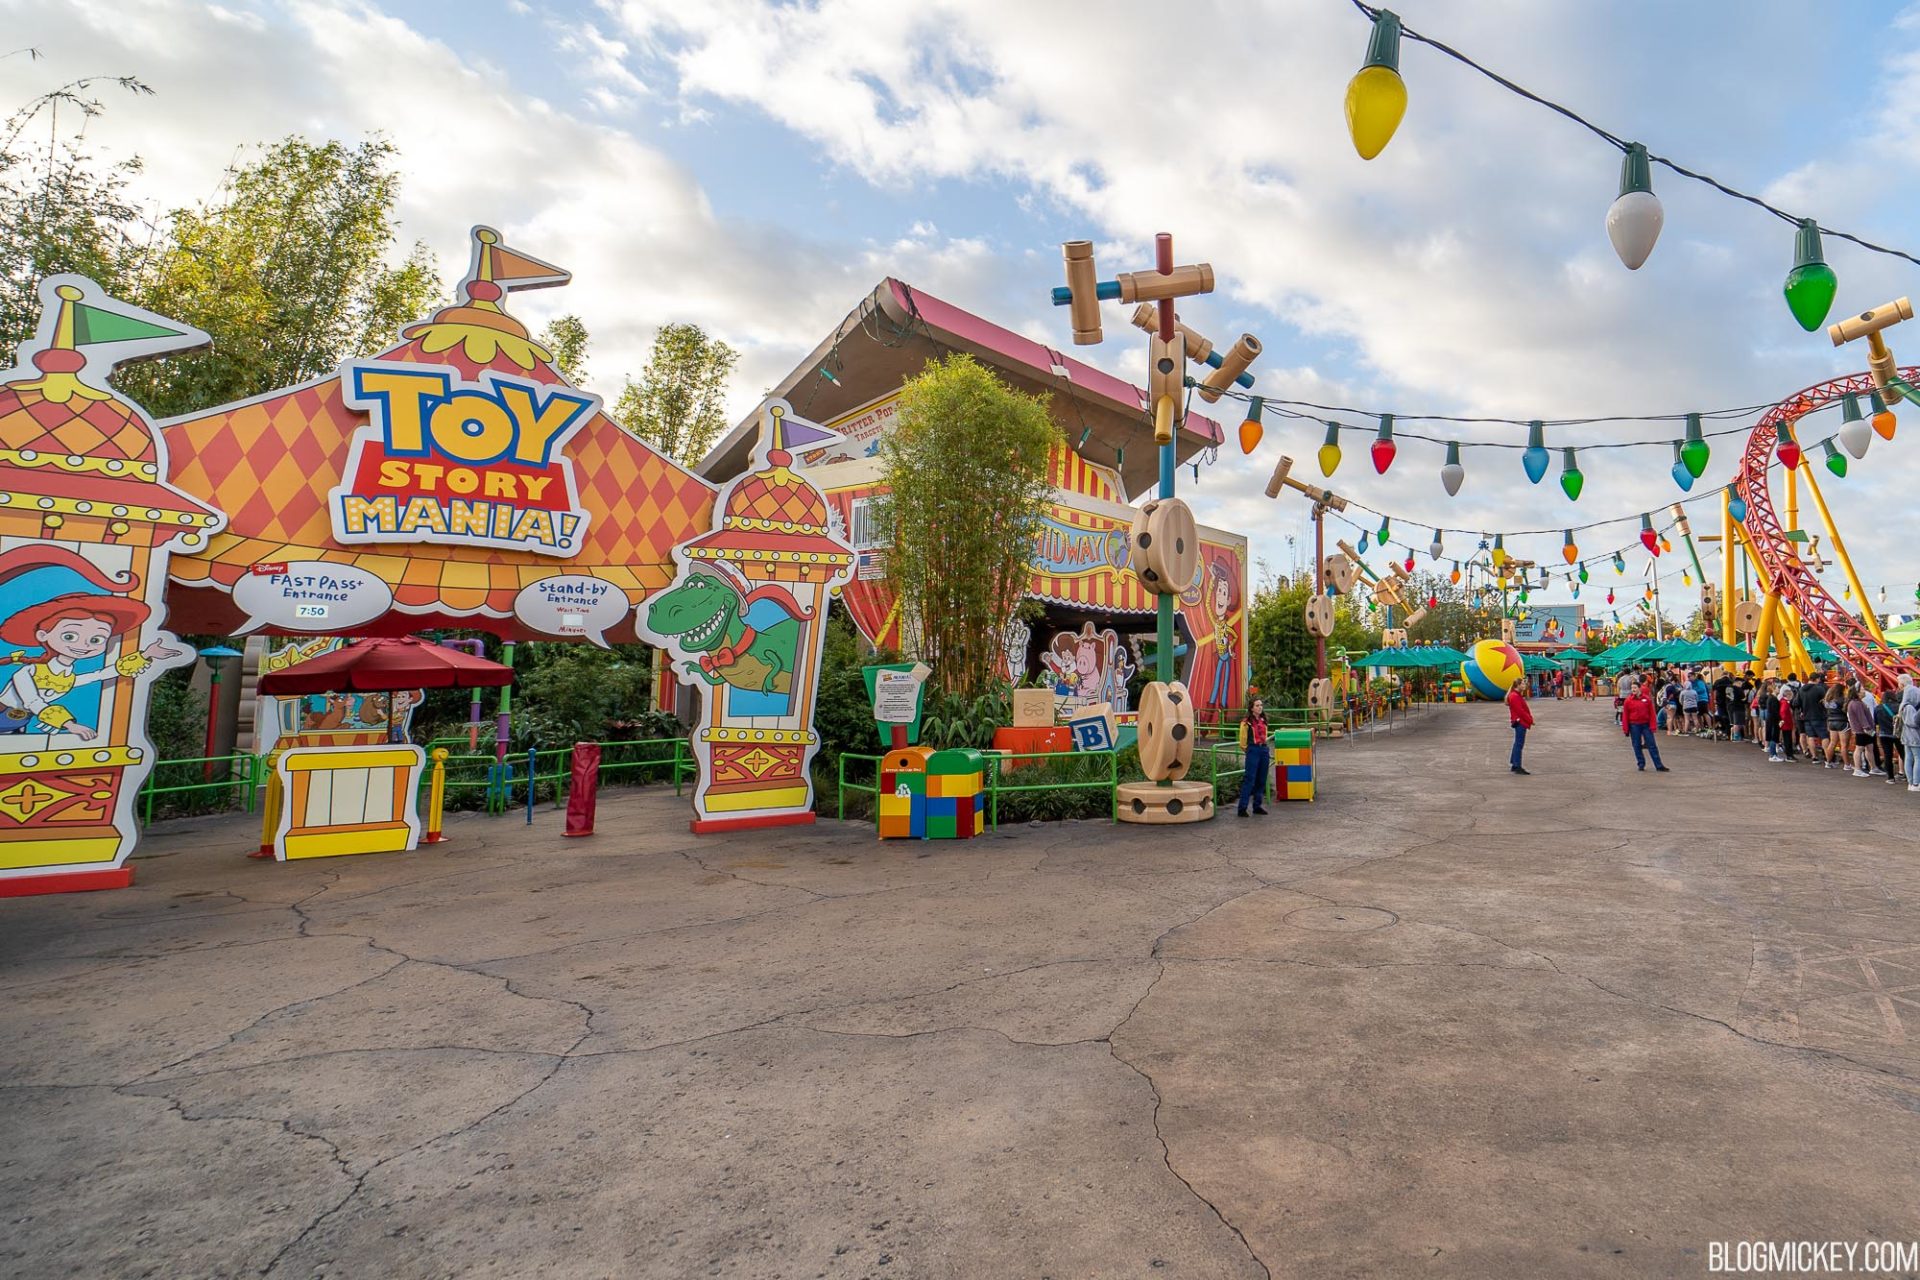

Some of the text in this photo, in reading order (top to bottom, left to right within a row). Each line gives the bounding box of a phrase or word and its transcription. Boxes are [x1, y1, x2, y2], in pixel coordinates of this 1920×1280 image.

[353, 367, 594, 470] TOY
[378, 460, 553, 501] STORY
[341, 494, 581, 549] MANIA!
[256, 564, 284, 573] Disney
[283, 587, 348, 601] Entrance
[539, 582, 608, 596] Stand-by
[547, 593, 599, 606] Entrance
[300, 607, 325, 616] 7:50
[1078, 724, 1103, 748] B
